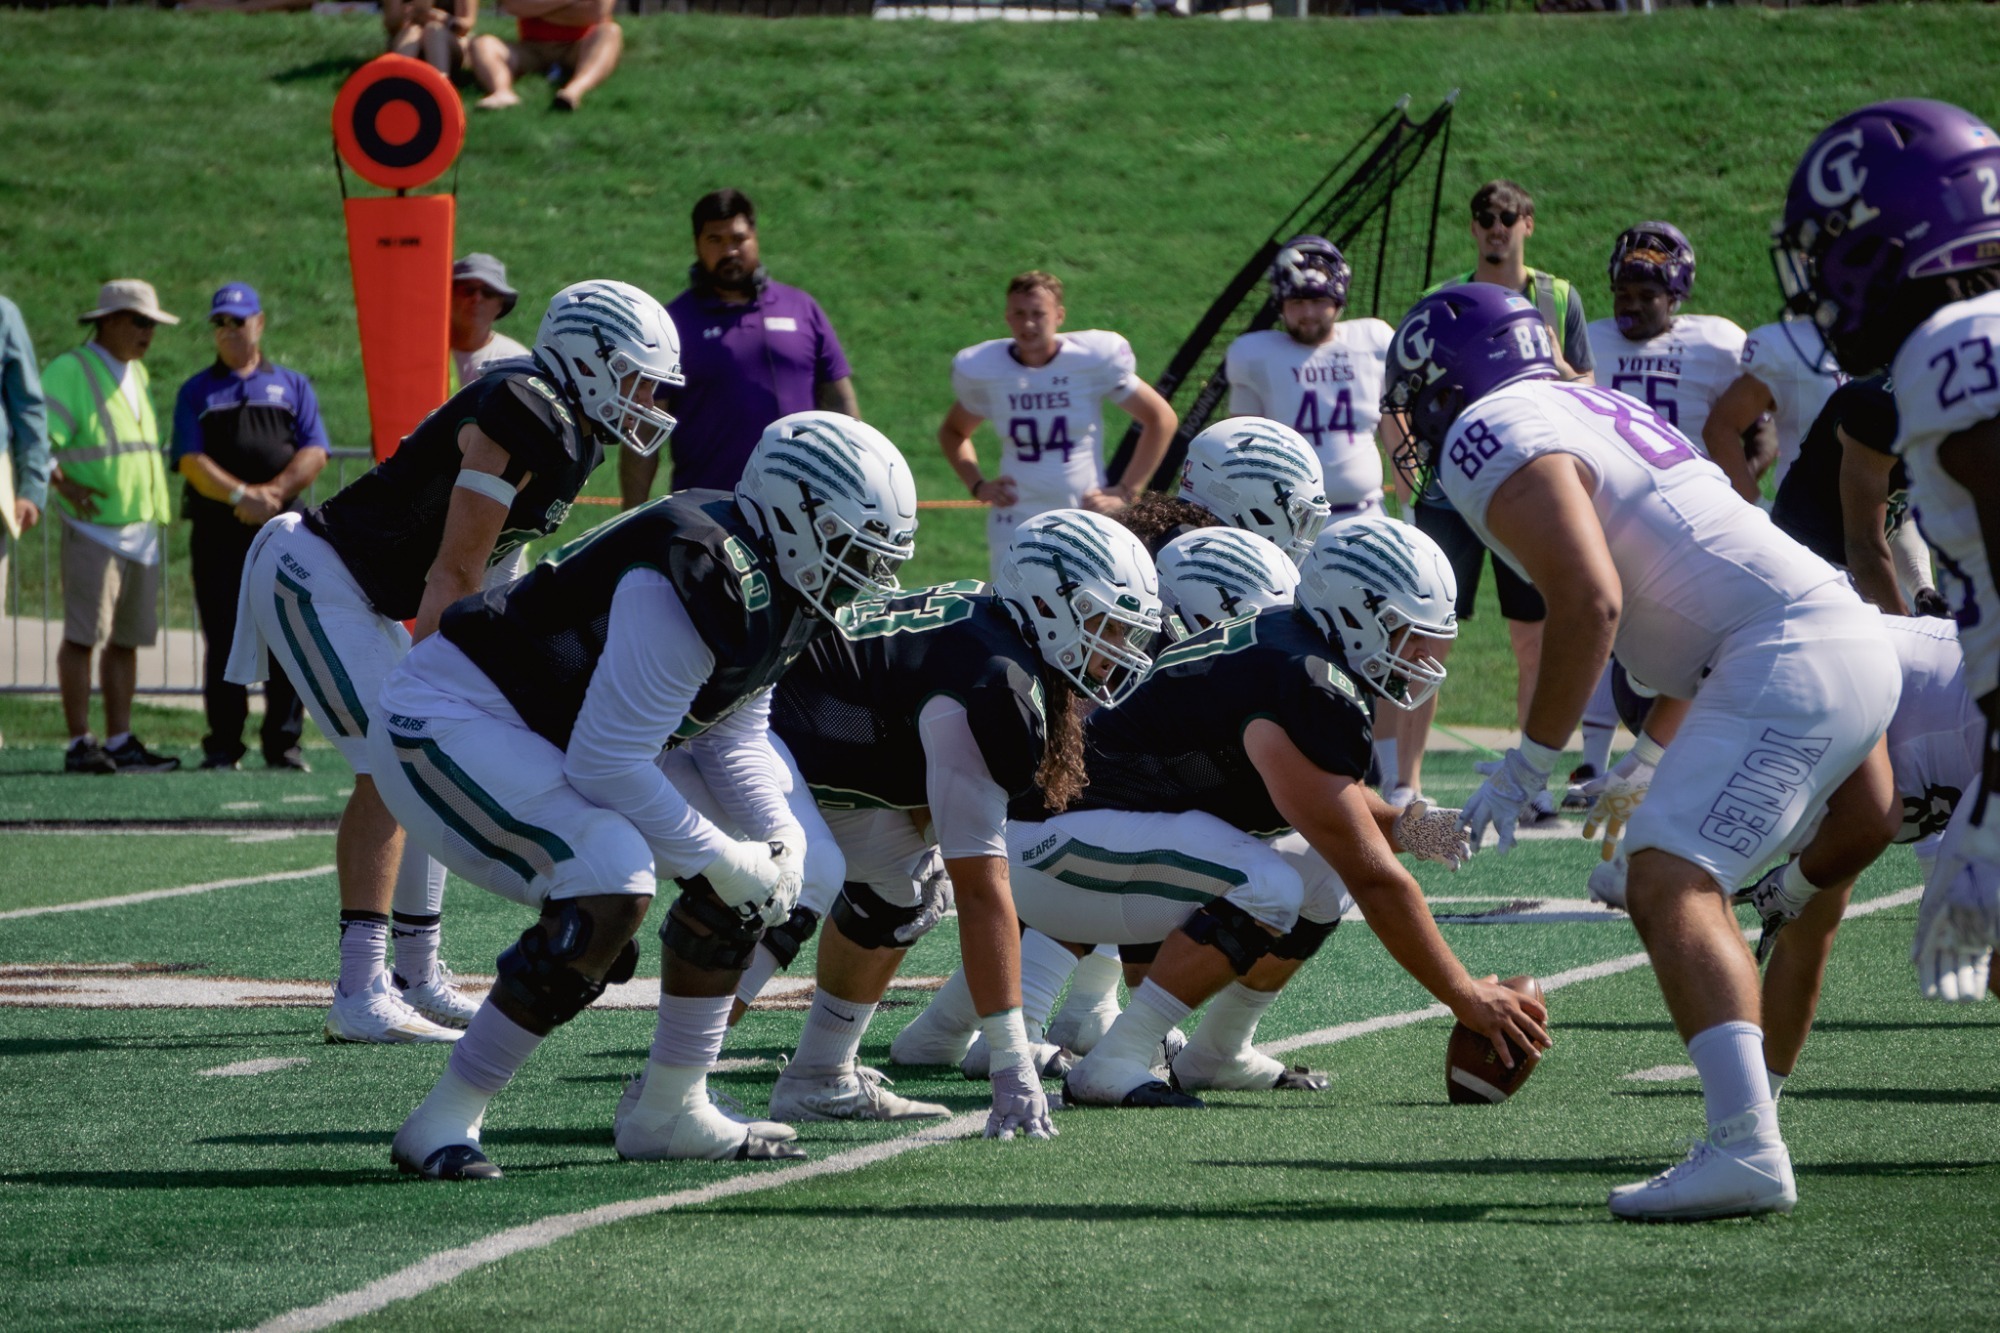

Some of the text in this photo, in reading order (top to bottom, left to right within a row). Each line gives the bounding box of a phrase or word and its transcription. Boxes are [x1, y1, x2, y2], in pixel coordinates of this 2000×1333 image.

[1291, 365, 1355, 383] YOTES
[1618, 357, 1681, 375] YOTES
[1928, 335, 1999, 411] 23
[1008, 391, 1070, 411] YOTES
[1294, 387, 1356, 447] 44
[1009, 415, 1075, 463] 94
[1449, 418, 1504, 481] 88
[280, 552, 311, 580] BEARS
[389, 713, 426, 731] BEARS
[1699, 727, 1833, 859] YOTES
[1022, 833, 1057, 861] BEARS
